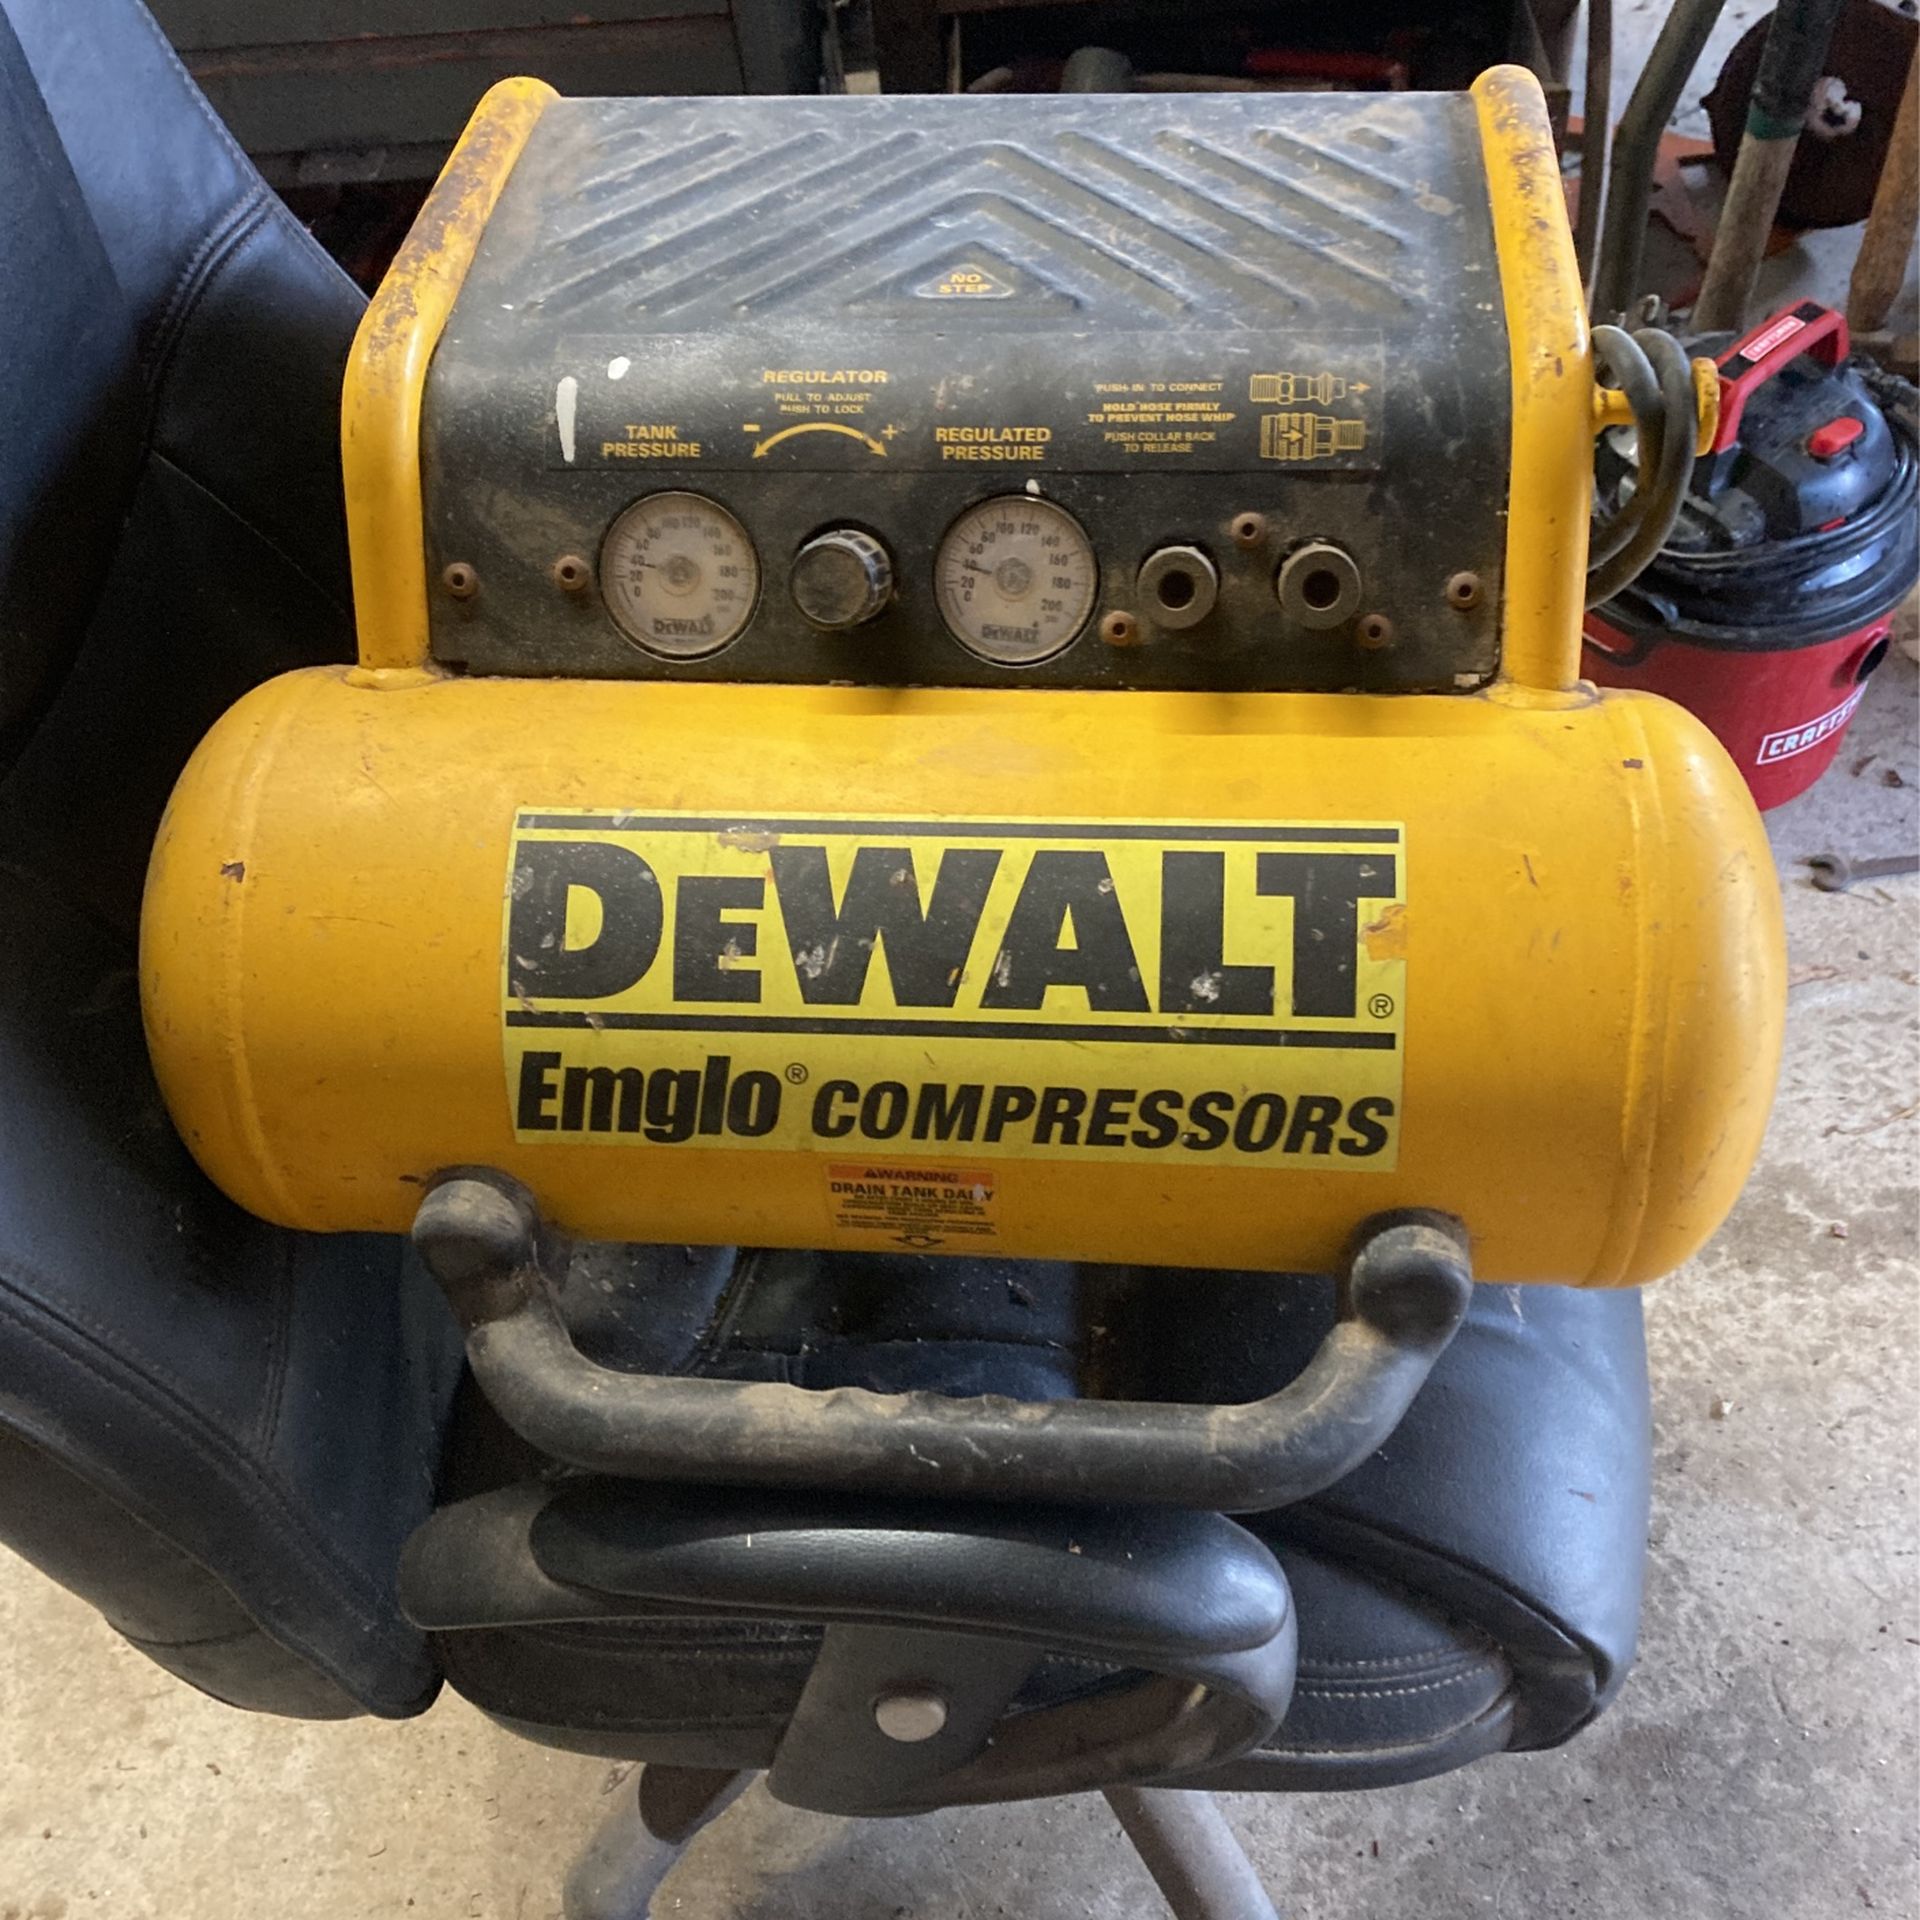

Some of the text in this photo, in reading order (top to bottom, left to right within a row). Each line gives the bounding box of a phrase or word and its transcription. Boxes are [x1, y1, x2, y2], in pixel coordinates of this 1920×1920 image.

[950, 273, 981, 283] NO
[939, 284, 992, 293] STEP
[763, 370, 888, 383] REGULATOR
[1151, 383, 1165, 392] TO
[1169, 382, 1223, 392] CONNECT
[775, 393, 872, 402] PULL TO ADJUST
[815, 405, 829, 414] TO
[835, 405, 864, 414] LOCK
[1088, 413, 1104, 422] TO
[625, 425, 677, 440] TANK
[935, 427, 1051, 442] REGULATED
[1105, 432, 1216, 442] PUSH COLLAR BACK
[603, 442, 701, 458] PRESSURE
[942, 445, 1044, 460] PRESSURE
[1124, 443, 1192, 452] TO RELEASE
[1021, 522, 1040, 535] 120
[630, 570, 643, 582] 20
[961, 576, 975, 589] 20
[811, 1079, 1395, 1157] COMPRESSORS
[876, 1168, 959, 1184] WARNING
[831, 1182, 886, 1196] DRAIN
[890, 1185, 938, 1199] TANK
